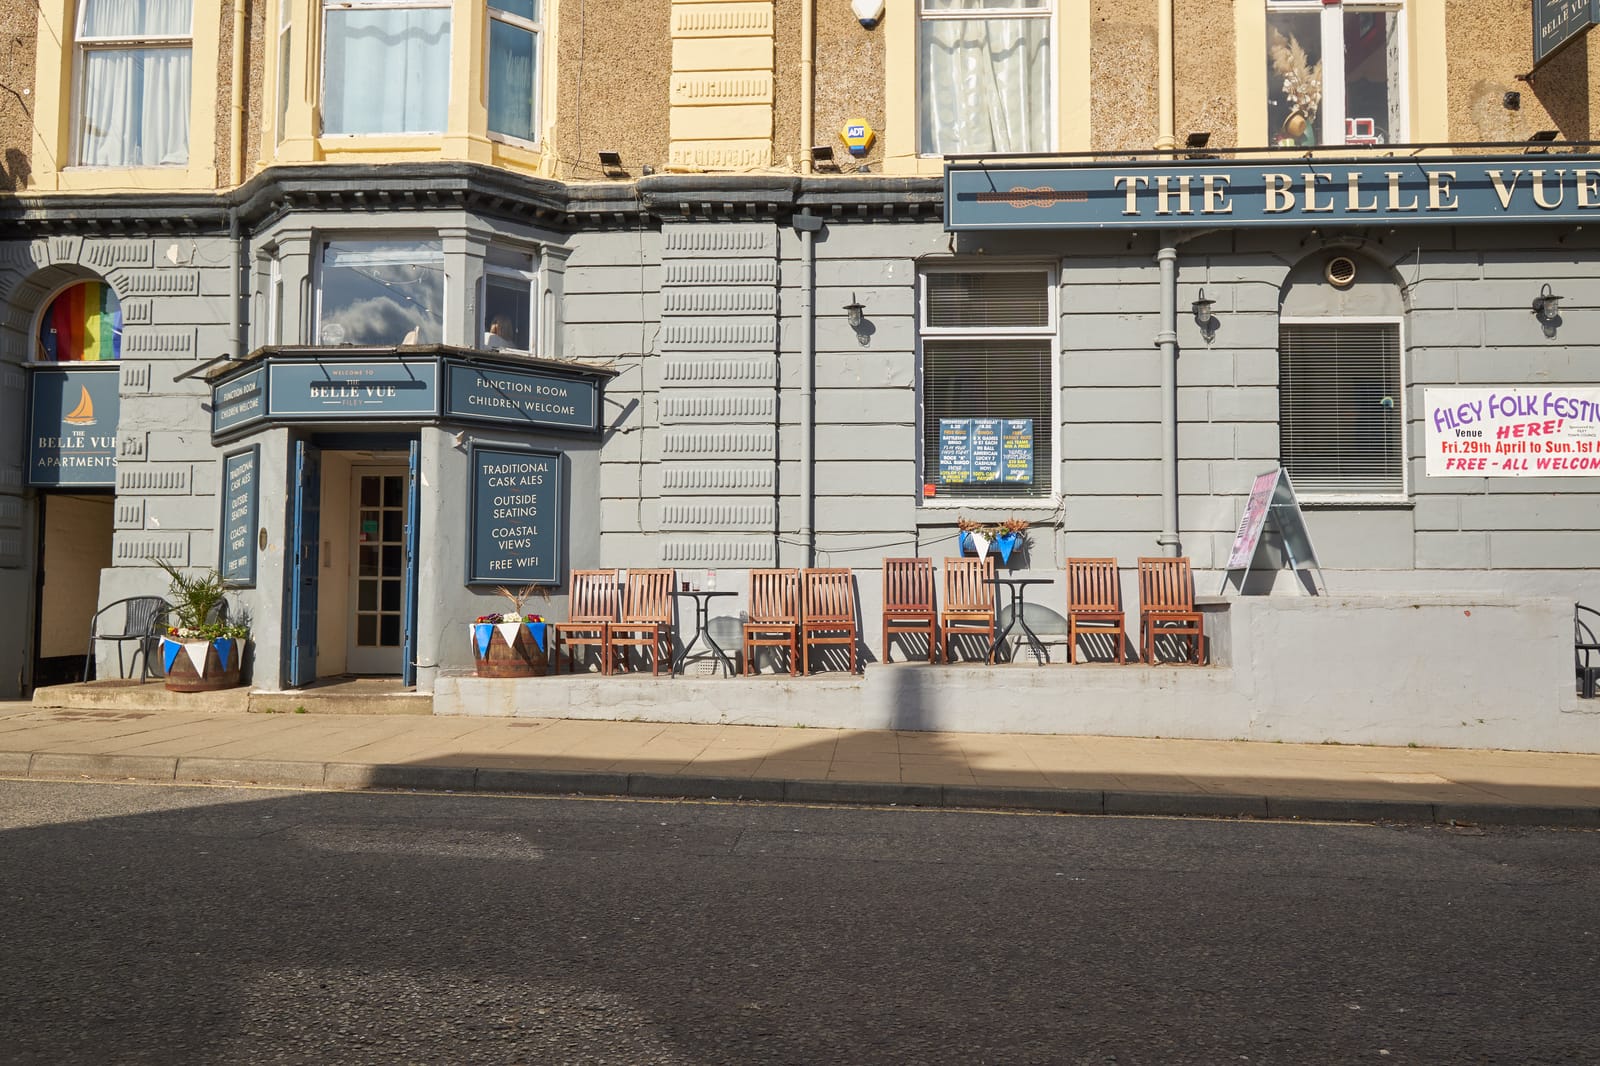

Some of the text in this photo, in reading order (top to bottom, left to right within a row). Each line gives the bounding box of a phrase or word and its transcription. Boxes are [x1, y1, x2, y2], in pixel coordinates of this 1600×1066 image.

[1542, 8, 1569, 38] BELLE
[848, 127, 864, 137] ADT
[1114, 168, 1600, 216] THE BELLE VUE
[223, 382, 257, 401] FUNCTION ROOM
[310, 385, 396, 398] BELLE VUE
[476, 378, 568, 397] FUNCTION ROOM
[221, 398, 259, 420] CHILDREN WELCOME
[468, 395, 576, 415] CHILDREN WELCOME
[1433, 400, 1483, 433] FILEY
[1488, 393, 1539, 419] FOLK
[1455, 418, 1564, 440] Venue HERE!
[38, 437, 85, 448] BELLE
[1495, 440, 1526, 455] April
[1530, 441, 1541, 453] to
[38, 456, 119, 467] APARTMENTS
[1446, 457, 1488, 471] FREE
[1502, 457, 1529, 471] ALL
[229, 459, 253, 480] TRADITIONAL
[482, 463, 549, 475] TRADITIONAL
[231, 472, 251, 491] CASK ALES
[488, 475, 543, 487] CASK ALES
[231, 492, 248, 509] OUTSIDE
[493, 494, 537, 506] OUTSIDE
[231, 505, 248, 521] SEATING
[493, 507, 537, 519] SEATING
[230, 524, 248, 540] COASTAL
[491, 526, 538, 538] COASTAL
[232, 538, 245, 551] VIEWS
[498, 538, 531, 550] VIEWS
[228, 559, 238, 571] FREE
[489, 556, 539, 570] FREE WIFI
